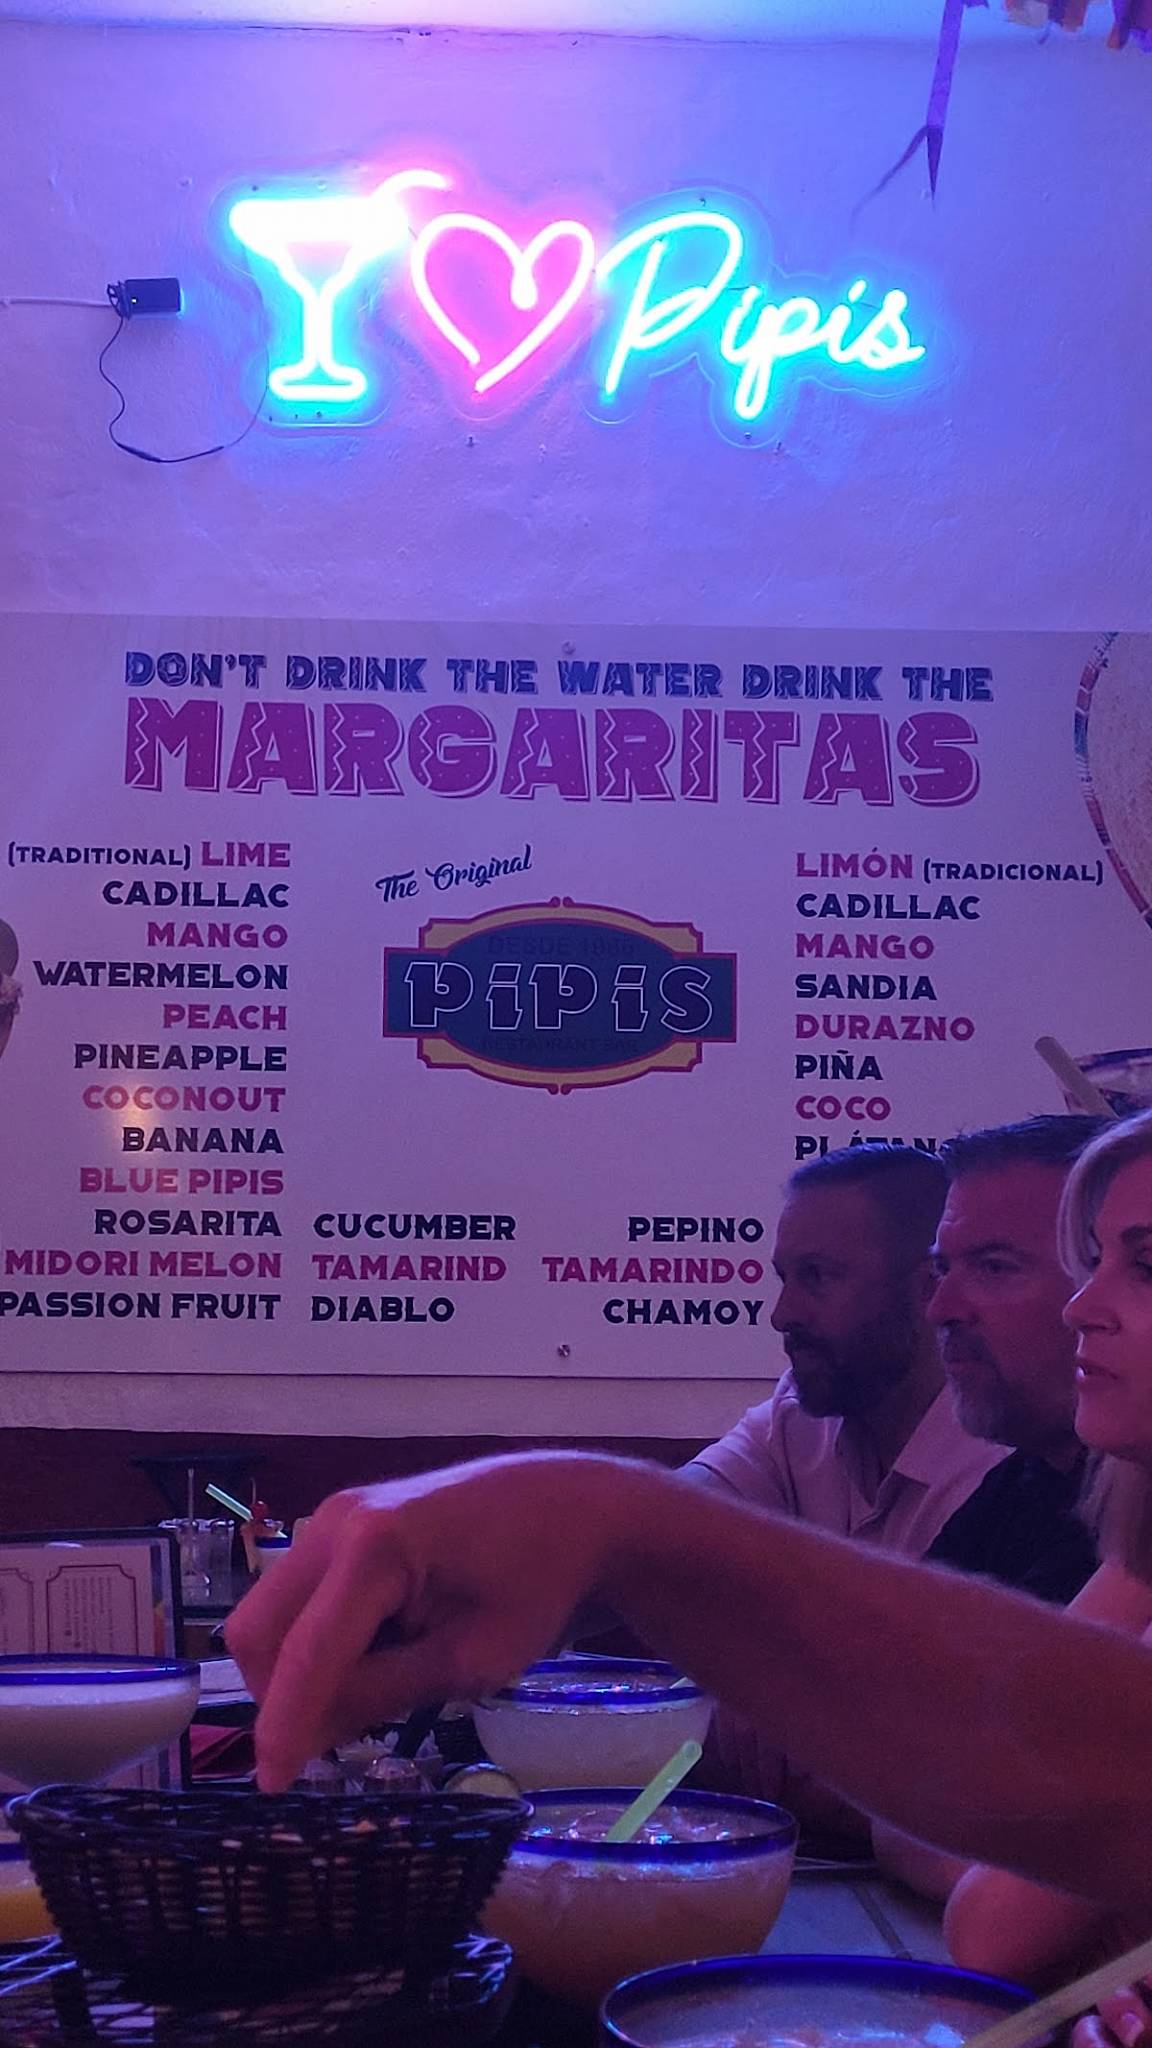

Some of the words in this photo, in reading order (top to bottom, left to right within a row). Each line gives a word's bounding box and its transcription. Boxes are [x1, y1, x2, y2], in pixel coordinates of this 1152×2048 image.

[595, 210, 926, 420] Pipis
[125, 652, 267, 689] DON'T
[286, 655, 427, 692] DRINK
[447, 658, 538, 694] THE
[558, 661, 723, 698] WATER
[743, 664, 883, 701] DRINK
[902, 667, 994, 702] THE
[125, 696, 981, 807] MARGARITAS
[9, 842, 190, 870] (TRADITIONAL)
[202, 842, 290, 867] LIME
[797, 847, 912, 878] LIMÓN
[924, 857, 1104, 886] (TRADICIONAL)
[375, 870, 419, 902] The
[425, 844, 532, 890] Original
[103, 881, 289, 908] CADILLAC
[796, 894, 980, 920] CADILLAC
[148, 922, 288, 948] MANGO
[796, 933, 934, 959] MANGO
[33, 961, 288, 989] WATERMELON
[796, 974, 937, 1000] SANDIA
[164, 1004, 287, 1030] PEACH
[796, 1014, 974, 1041] DURAZNO
[74, 1044, 286, 1071] PINEAPPLE
[796, 1050, 883, 1080] PIÑA
[82, 1085, 286, 1112] COCONOUT
[796, 1096, 891, 1120] COCO
[122, 1127, 284, 1154] BANANA
[80, 1167, 178, 1193] BLUE
[189, 1169, 283, 1195] PIPIS
[95, 1209, 282, 1236] ROSARITA
[313, 1214, 515, 1240] CUCUMBER
[629, 1217, 764, 1242] PEPINO
[5, 1250, 138, 1276] MIDORI
[150, 1251, 281, 1278] MELON
[312, 1255, 506, 1281] TAMARIND
[542, 1257, 763, 1283] TAMARINDO
[0, 1292, 160, 1318] PASSION
[171, 1293, 281, 1320] FRUIT
[311, 1296, 454, 1322] DIABLO
[603, 1299, 764, 1325] CHAMOY
